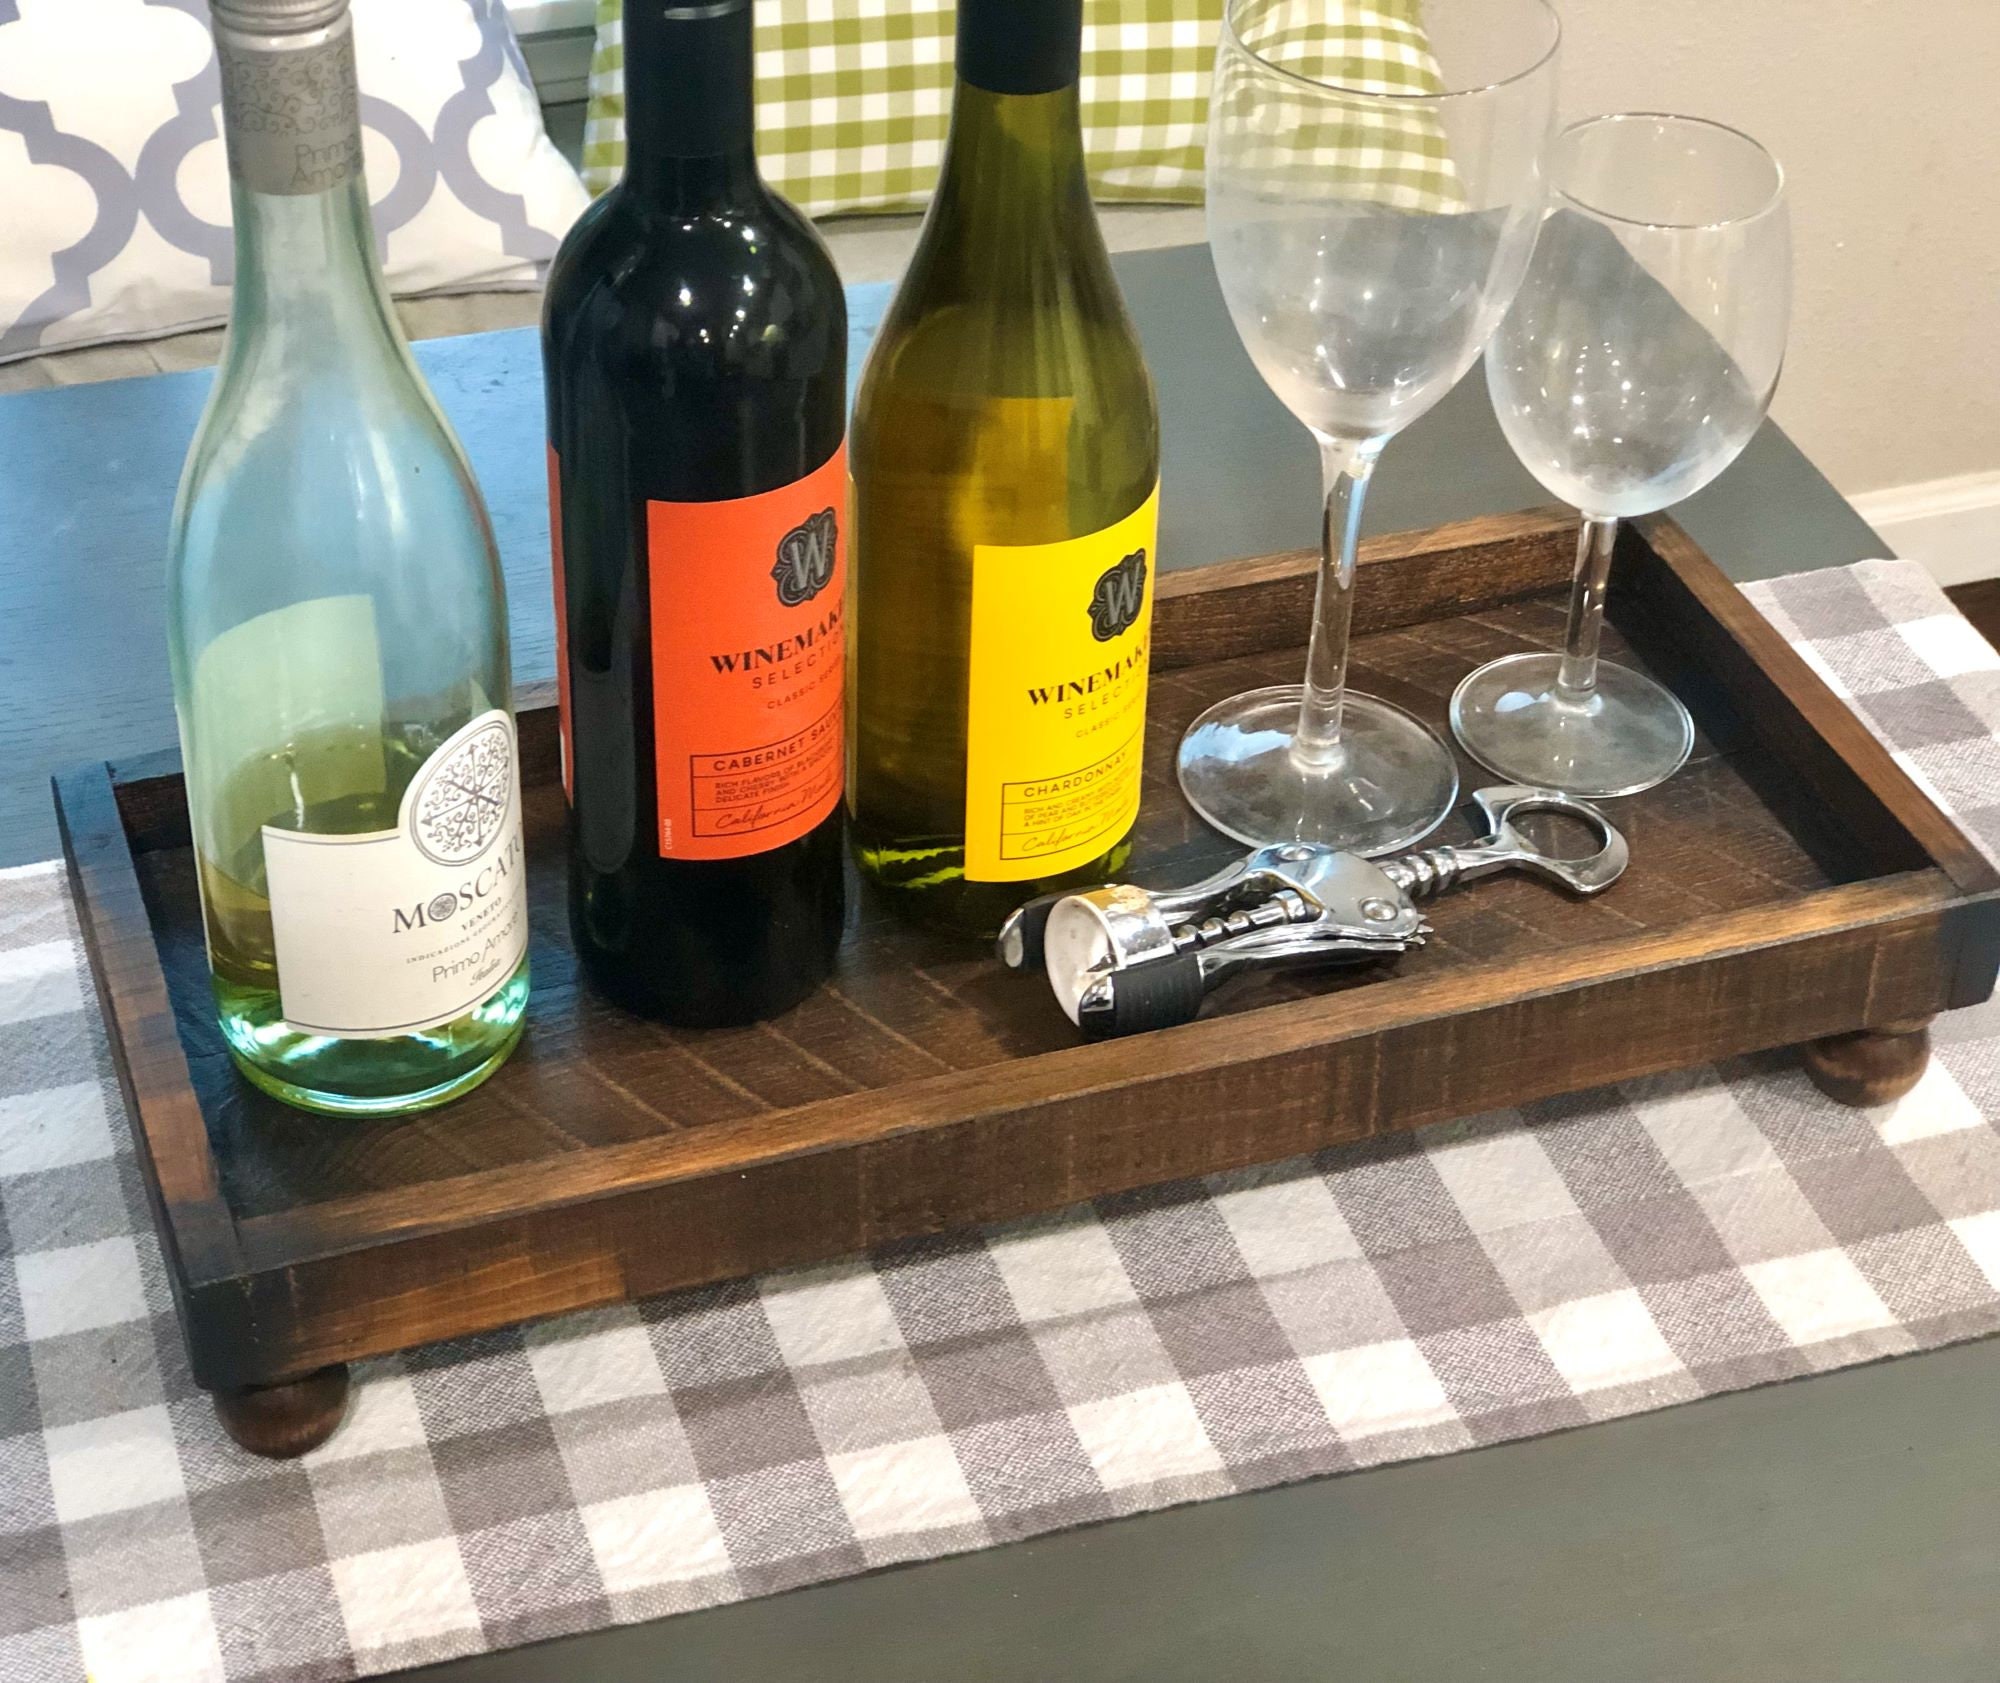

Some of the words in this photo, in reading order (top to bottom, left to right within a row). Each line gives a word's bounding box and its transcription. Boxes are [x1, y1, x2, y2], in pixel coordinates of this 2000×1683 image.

[752, 624, 842, 689] SELECTIO
[767, 681, 816, 709] CLASSIC
[713, 737, 805, 771] CABERNET
[1023, 751, 1126, 798] CHARDONNAY
[432, 951, 481, 983] Primo
